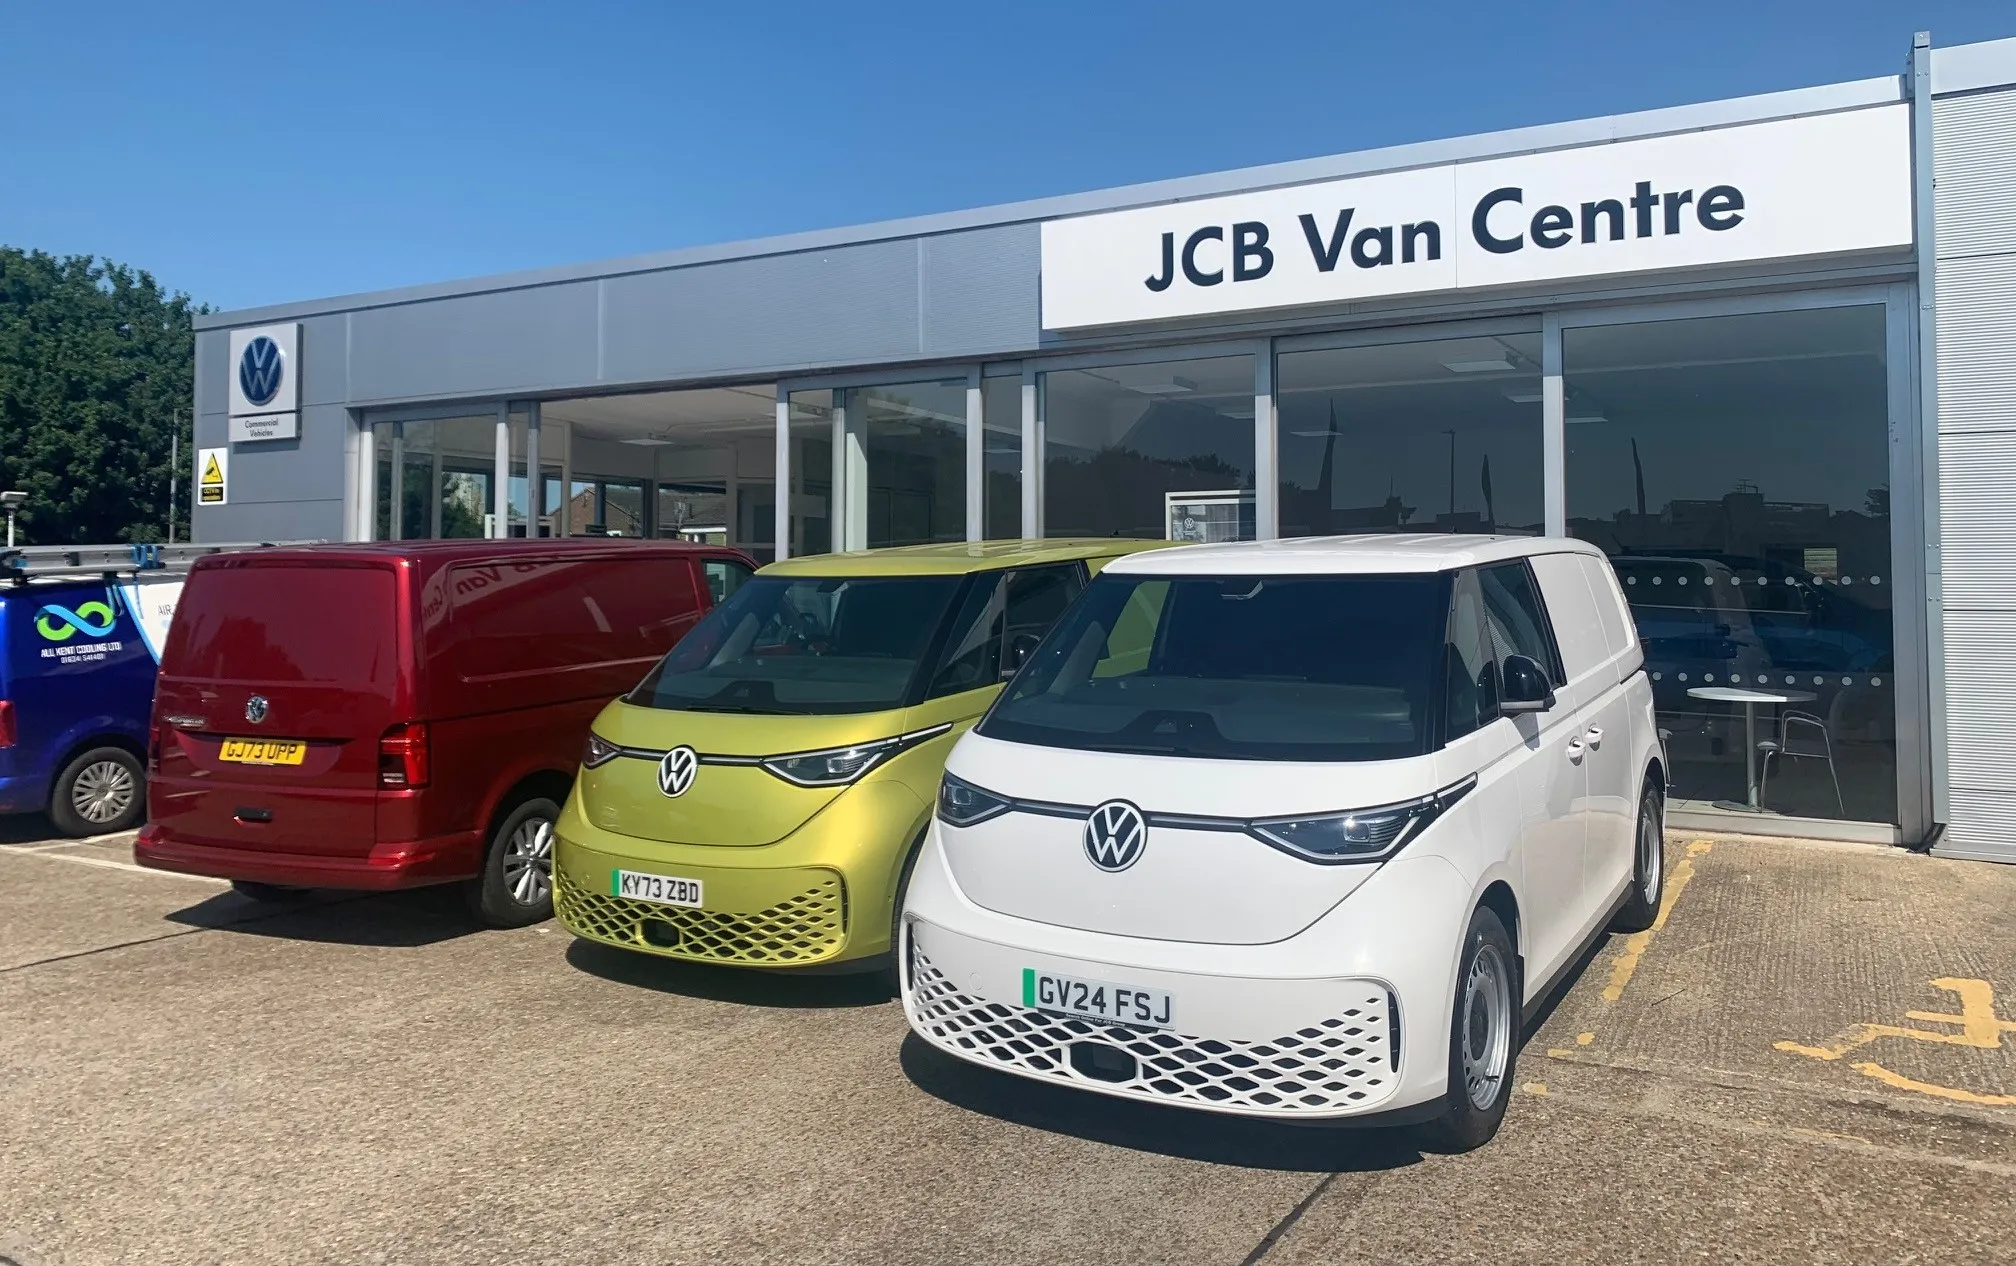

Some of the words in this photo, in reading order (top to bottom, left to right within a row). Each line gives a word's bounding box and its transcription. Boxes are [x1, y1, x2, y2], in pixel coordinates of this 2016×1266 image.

[1144, 222, 1274, 292] JCB
[1298, 207, 1441, 273] Van
[1472, 180, 1744, 254] Centre
[244, 418, 279, 428] Commercial
[249, 428, 273, 437] Vehicles
[41, 648, 55, 658] ALL
[56, 646, 75, 656] KENT
[76, 643, 107, 654] COOLING
[227, 740, 264, 759] GJ73
[267, 742, 298, 760] UPP
[622, 873, 661, 898] KY73
[667, 880, 699, 903] ZBD
[1039, 976, 1107, 1014] GV24
[1115, 988, 1170, 1024] FSJ
